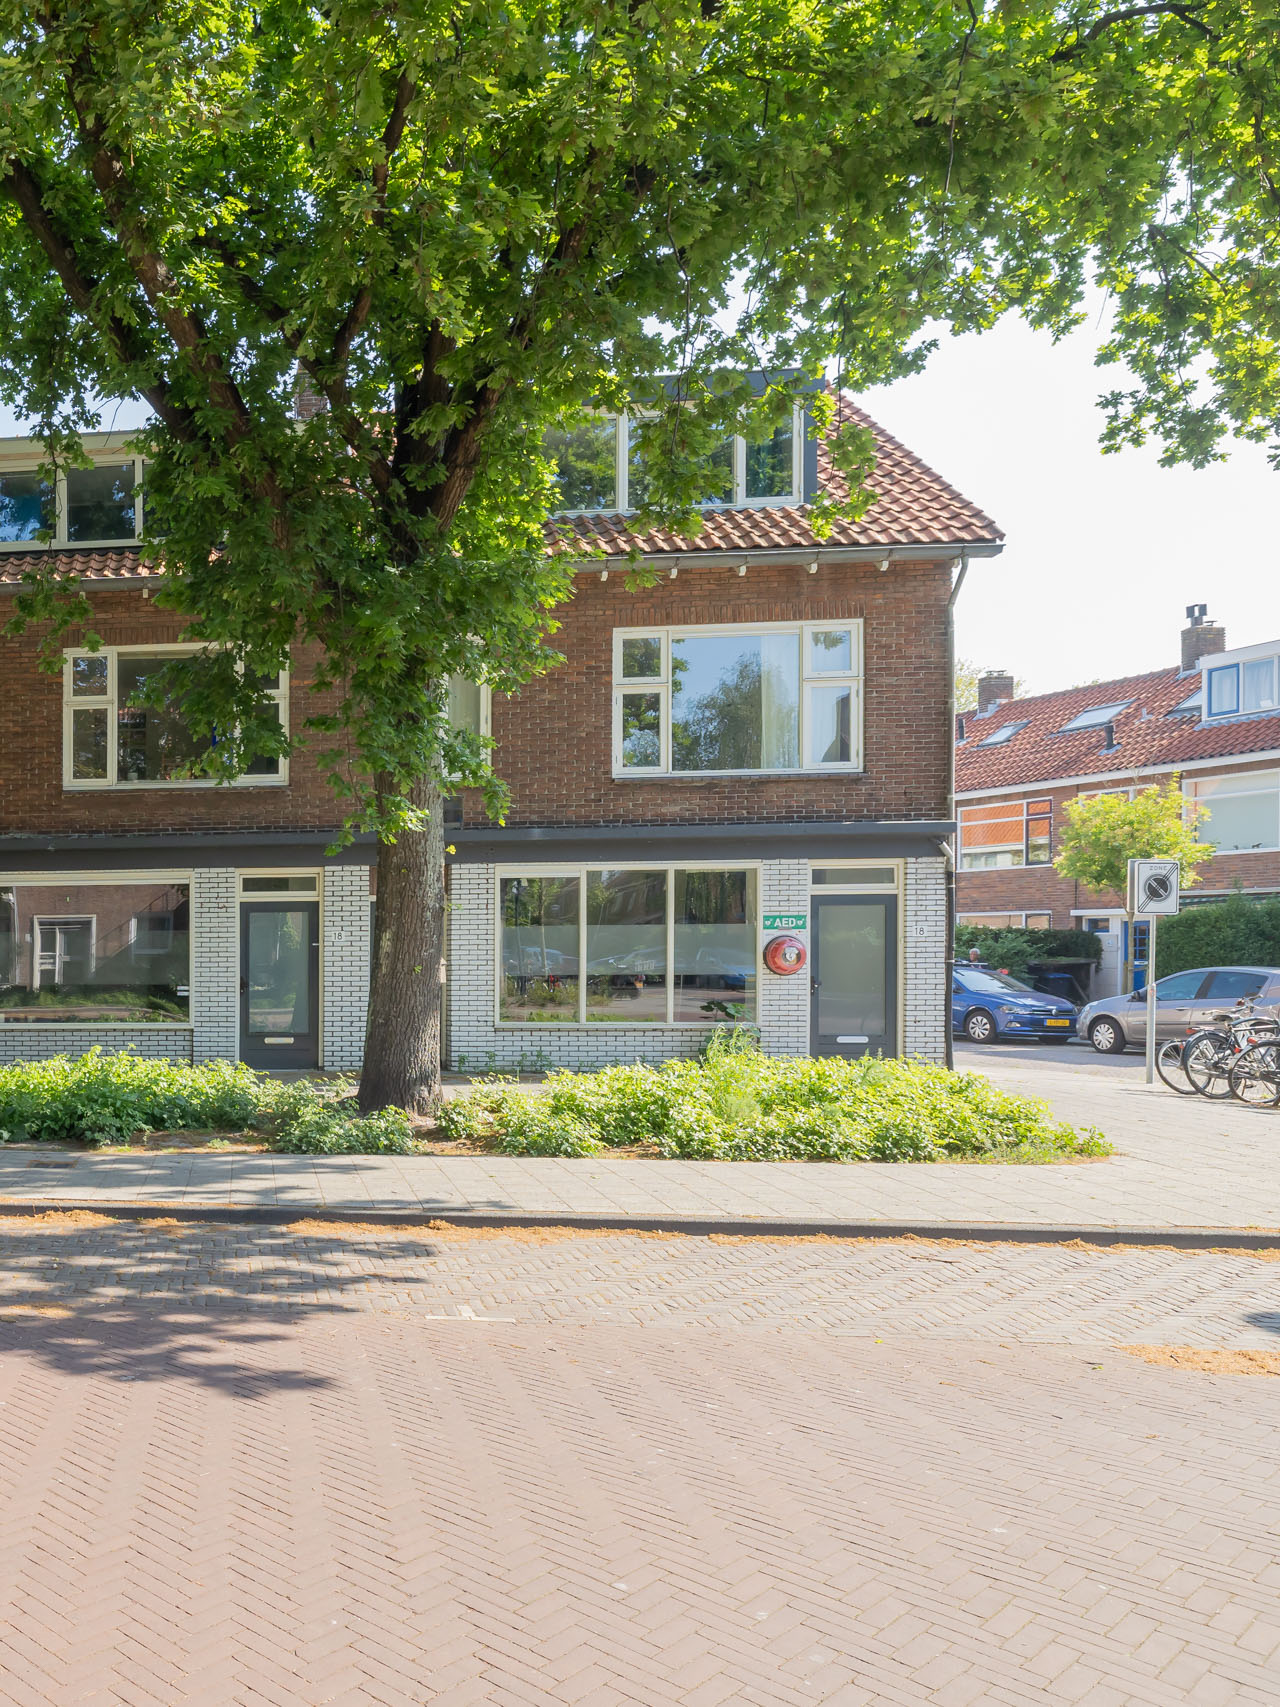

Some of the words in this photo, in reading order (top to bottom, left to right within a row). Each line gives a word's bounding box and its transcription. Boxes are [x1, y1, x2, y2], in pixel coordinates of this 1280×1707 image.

[774, 918, 796, 927] AED
[334, 932, 342, 940] 18
[915, 927, 925, 936] 18
